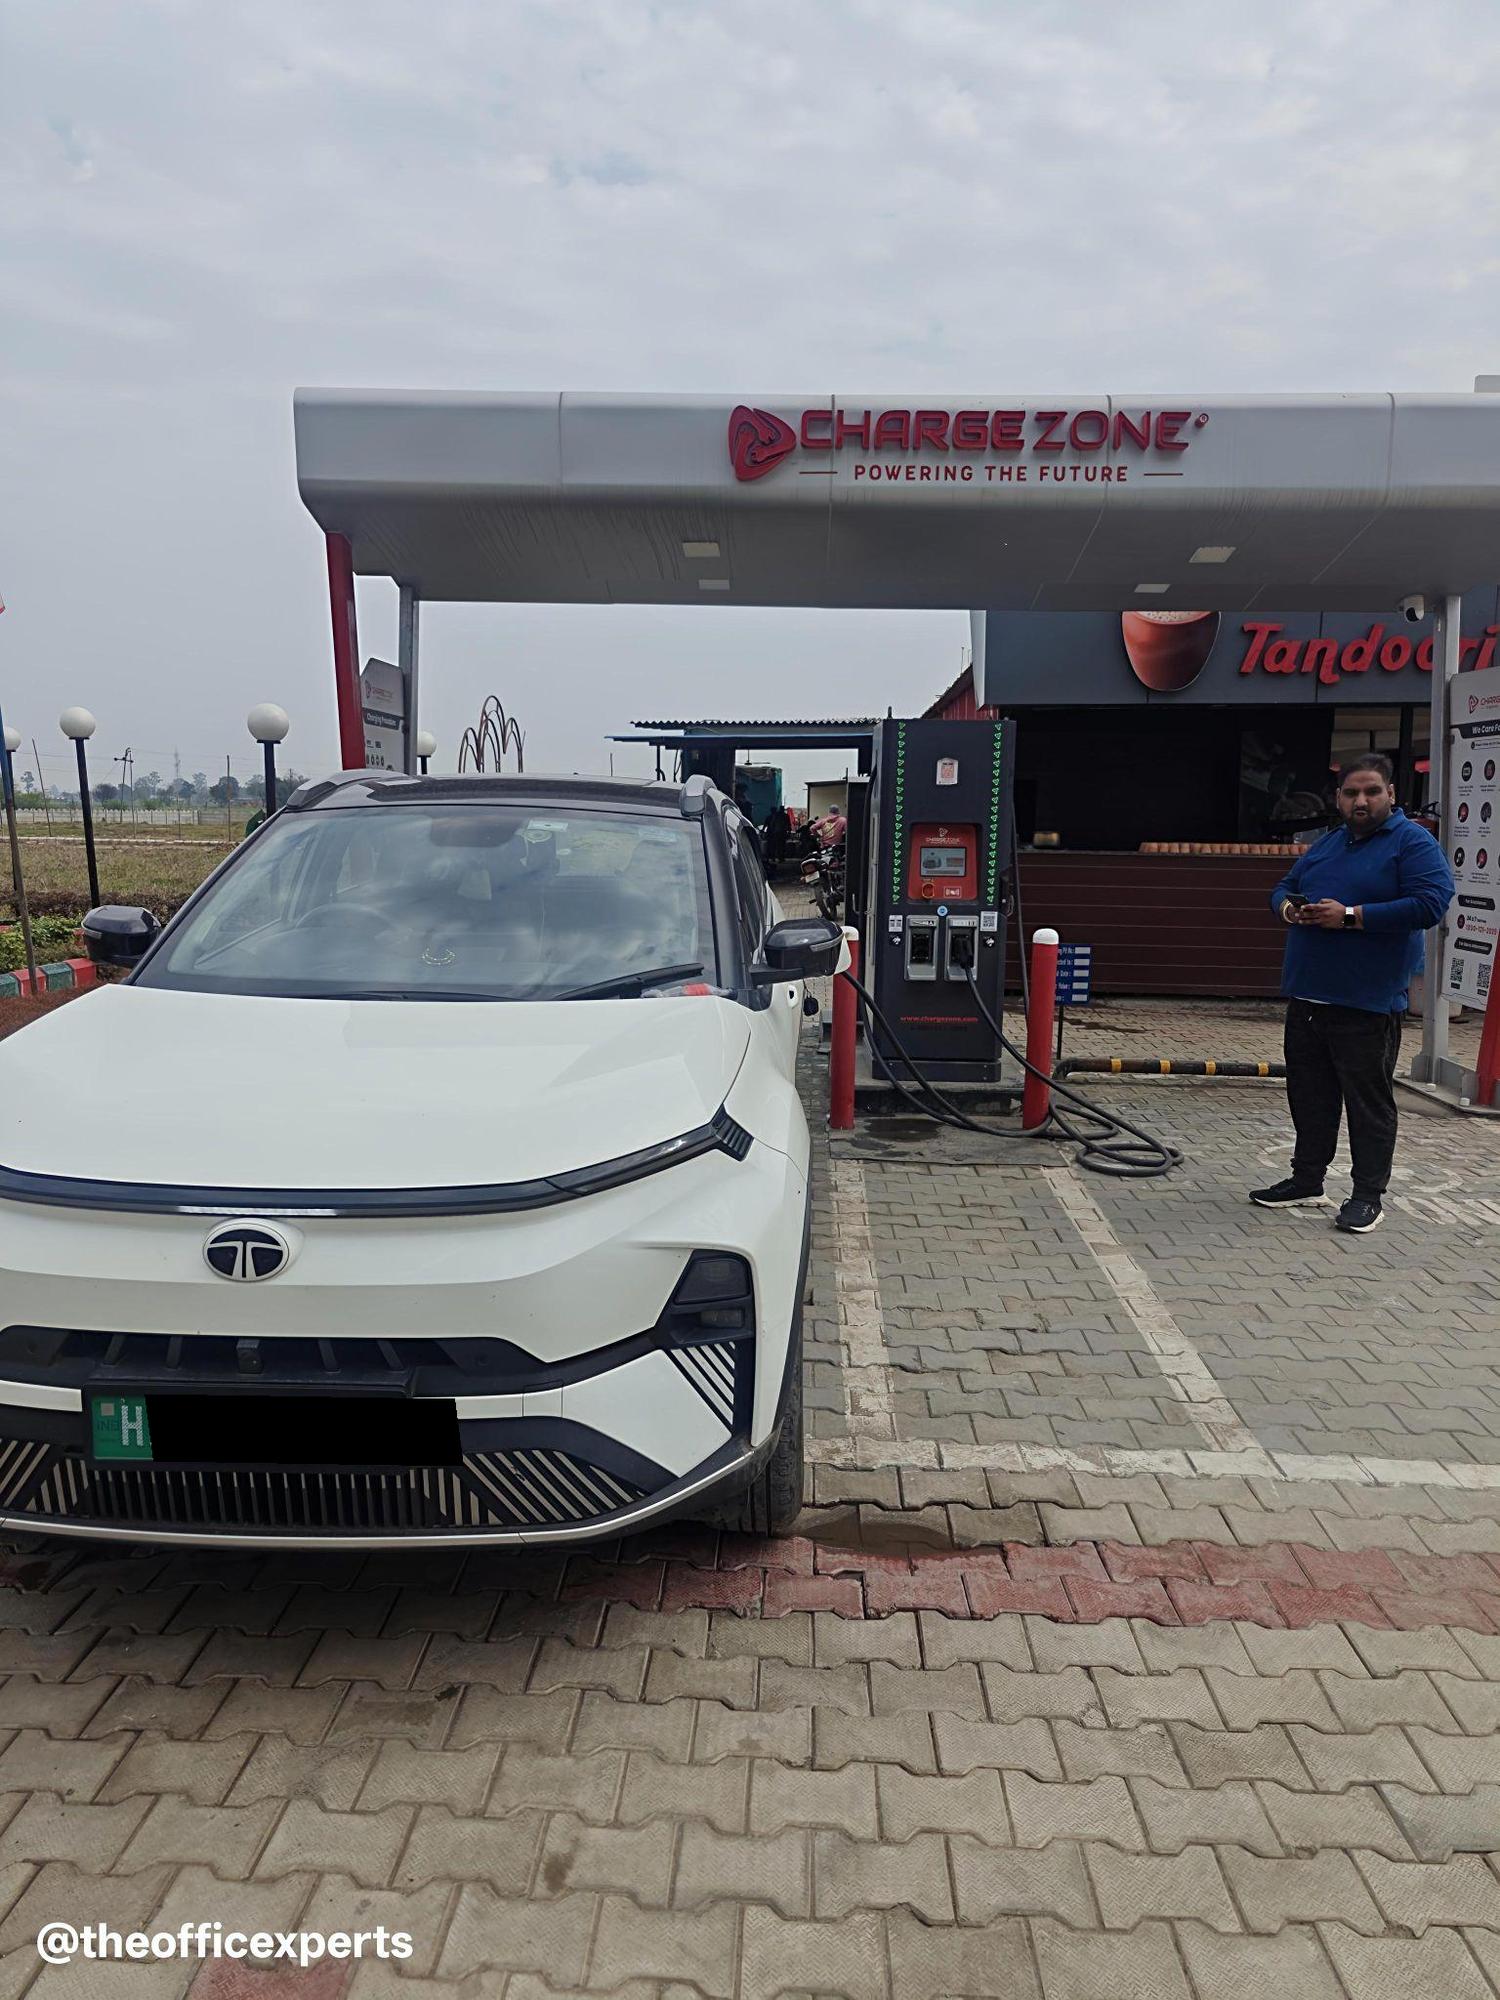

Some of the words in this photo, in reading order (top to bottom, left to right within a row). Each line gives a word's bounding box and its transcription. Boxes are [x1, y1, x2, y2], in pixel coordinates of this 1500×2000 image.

[855, 464, 974, 481] POWERING
[986, 465, 1027, 481] THE
[1039, 465, 1128, 481] FUTURE
